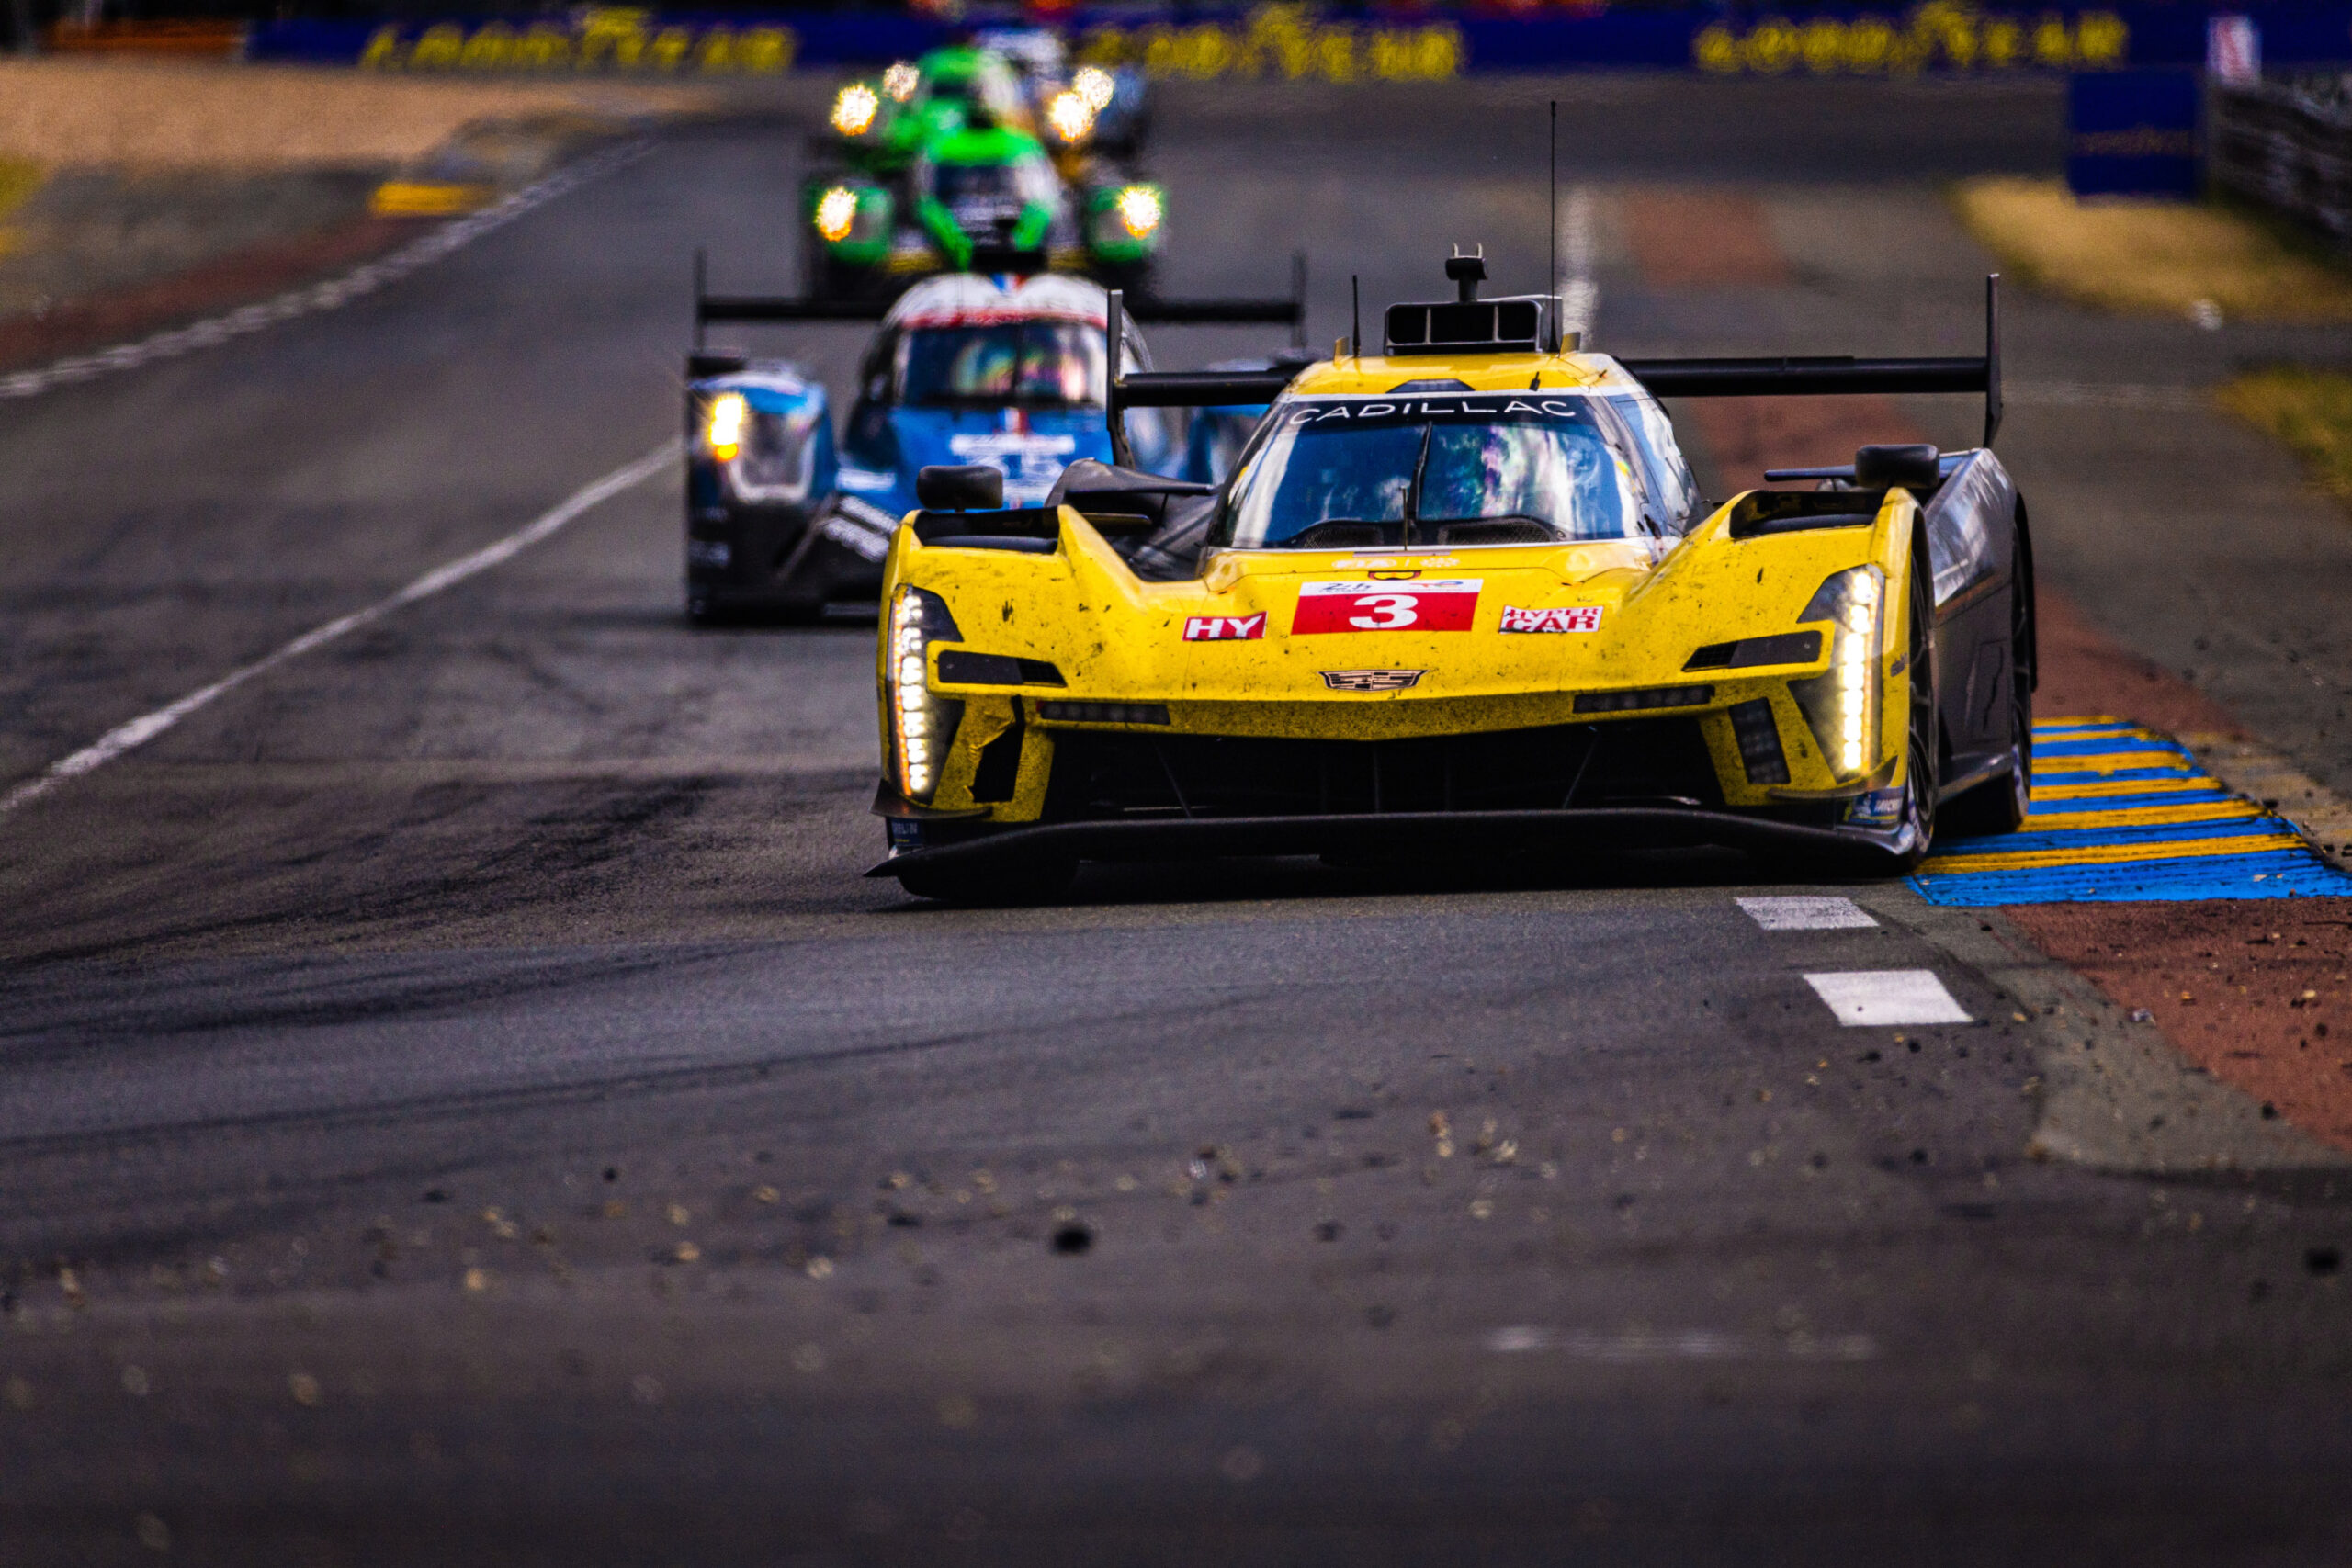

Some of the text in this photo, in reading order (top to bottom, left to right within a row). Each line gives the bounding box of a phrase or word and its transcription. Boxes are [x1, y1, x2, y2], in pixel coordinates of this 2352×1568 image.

[1289, 400, 1577, 425] CADILLAC
[1349, 594, 1419, 628] 3
[1510, 608, 1599, 618] HYPER
[1186, 615, 1262, 638] HY
[1505, 615, 1596, 632] CAR
